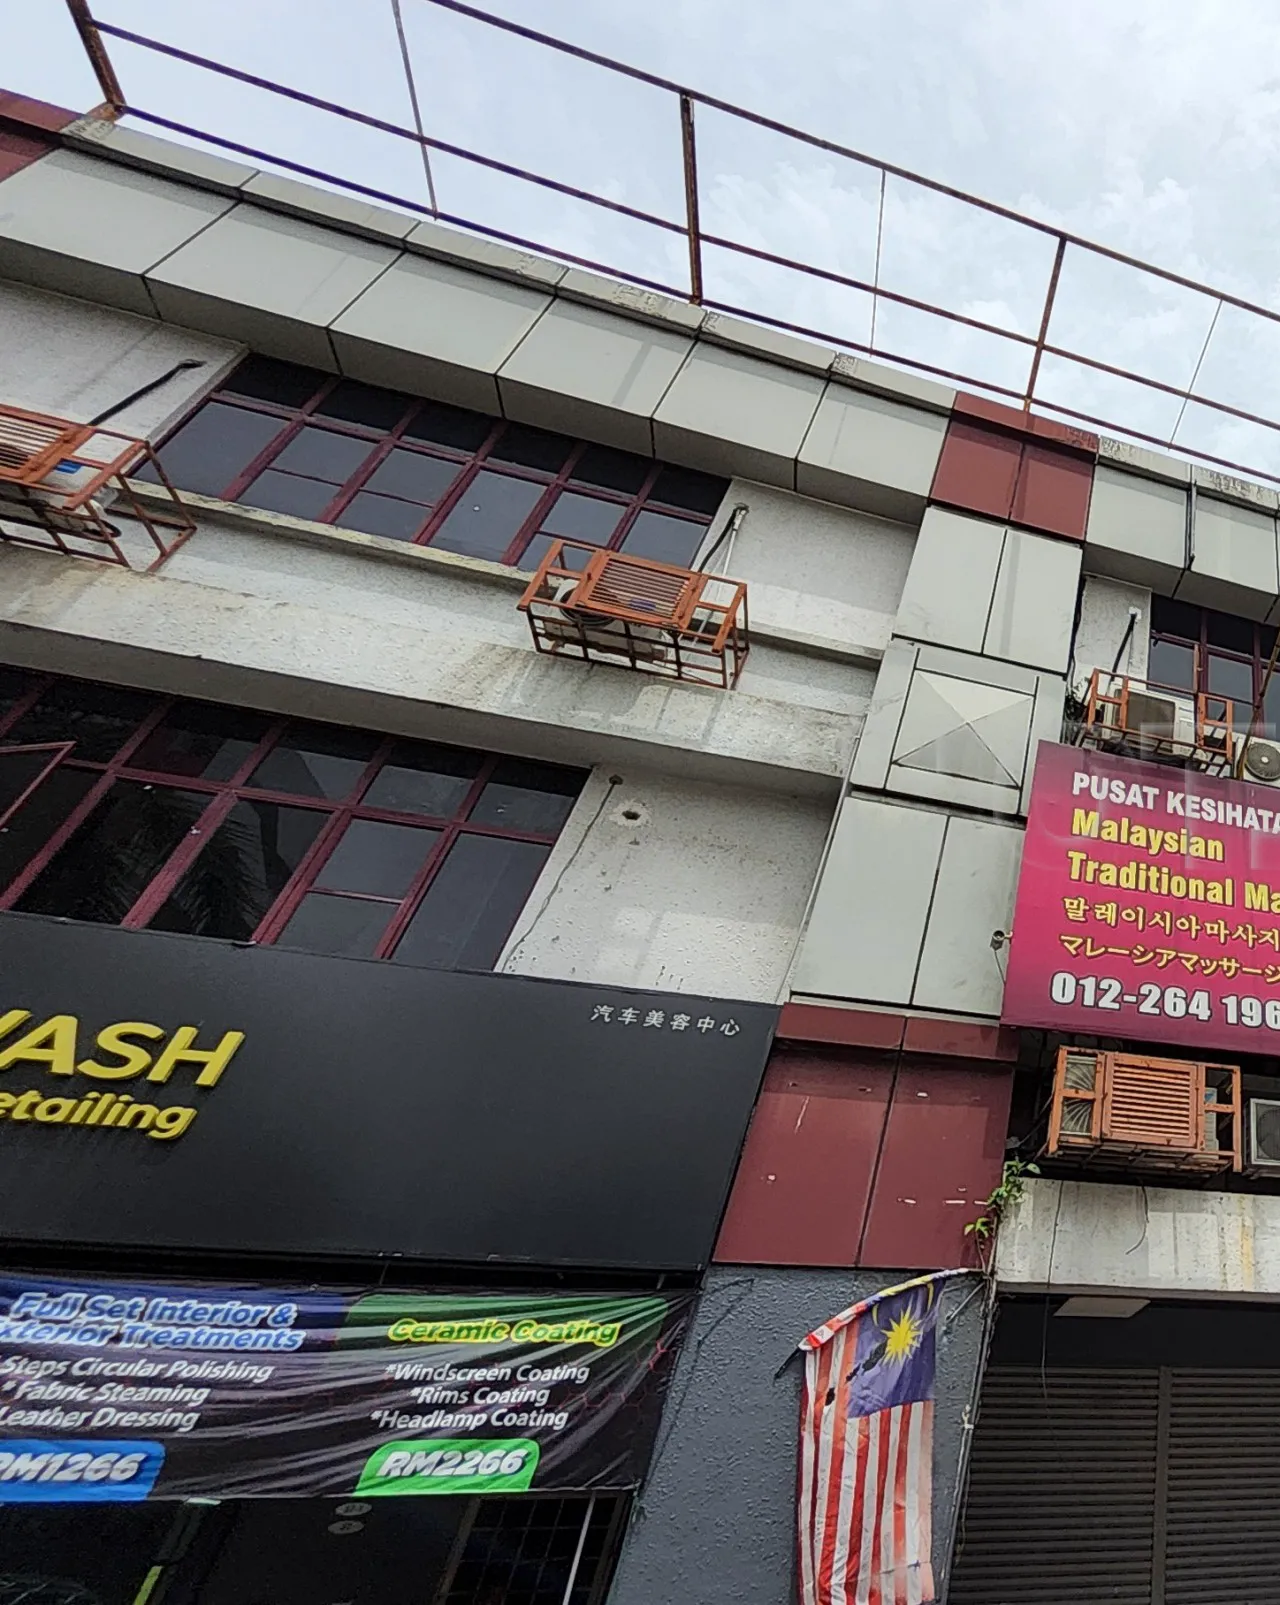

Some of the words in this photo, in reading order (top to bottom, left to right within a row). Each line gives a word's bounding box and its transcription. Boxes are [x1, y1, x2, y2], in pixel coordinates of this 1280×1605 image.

[1072, 771, 1161, 811] PUSAT
[1071, 808, 1225, 862] Malaysian
[1067, 850, 1234, 906] Traditional
[1051, 971, 1212, 1022] 012-264
[590, 1004, 740, 1036] 汽车美容中心
[11, 1292, 87, 1320] Full
[85, 1295, 146, 1321] Set
[146, 1298, 275, 1327] Interior
[267, 1303, 299, 1327] &
[117, 1323, 306, 1350] Treatments
[388, 1318, 509, 1343] Ceramic
[511, 1320, 622, 1347] Coating
[72, 1356, 167, 1379] Circular
[164, 1360, 276, 1384] Polishing
[515, 1363, 590, 1384] Coating
[14, 1379, 98, 1401] Fabric
[96, 1382, 211, 1406] Steaming
[472, 1387, 550, 1406] Coating
[90, 1406, 201, 1433] Dressing
[490, 1410, 569, 1431] Coating
[376, 1449, 530, 1478] RM2266
